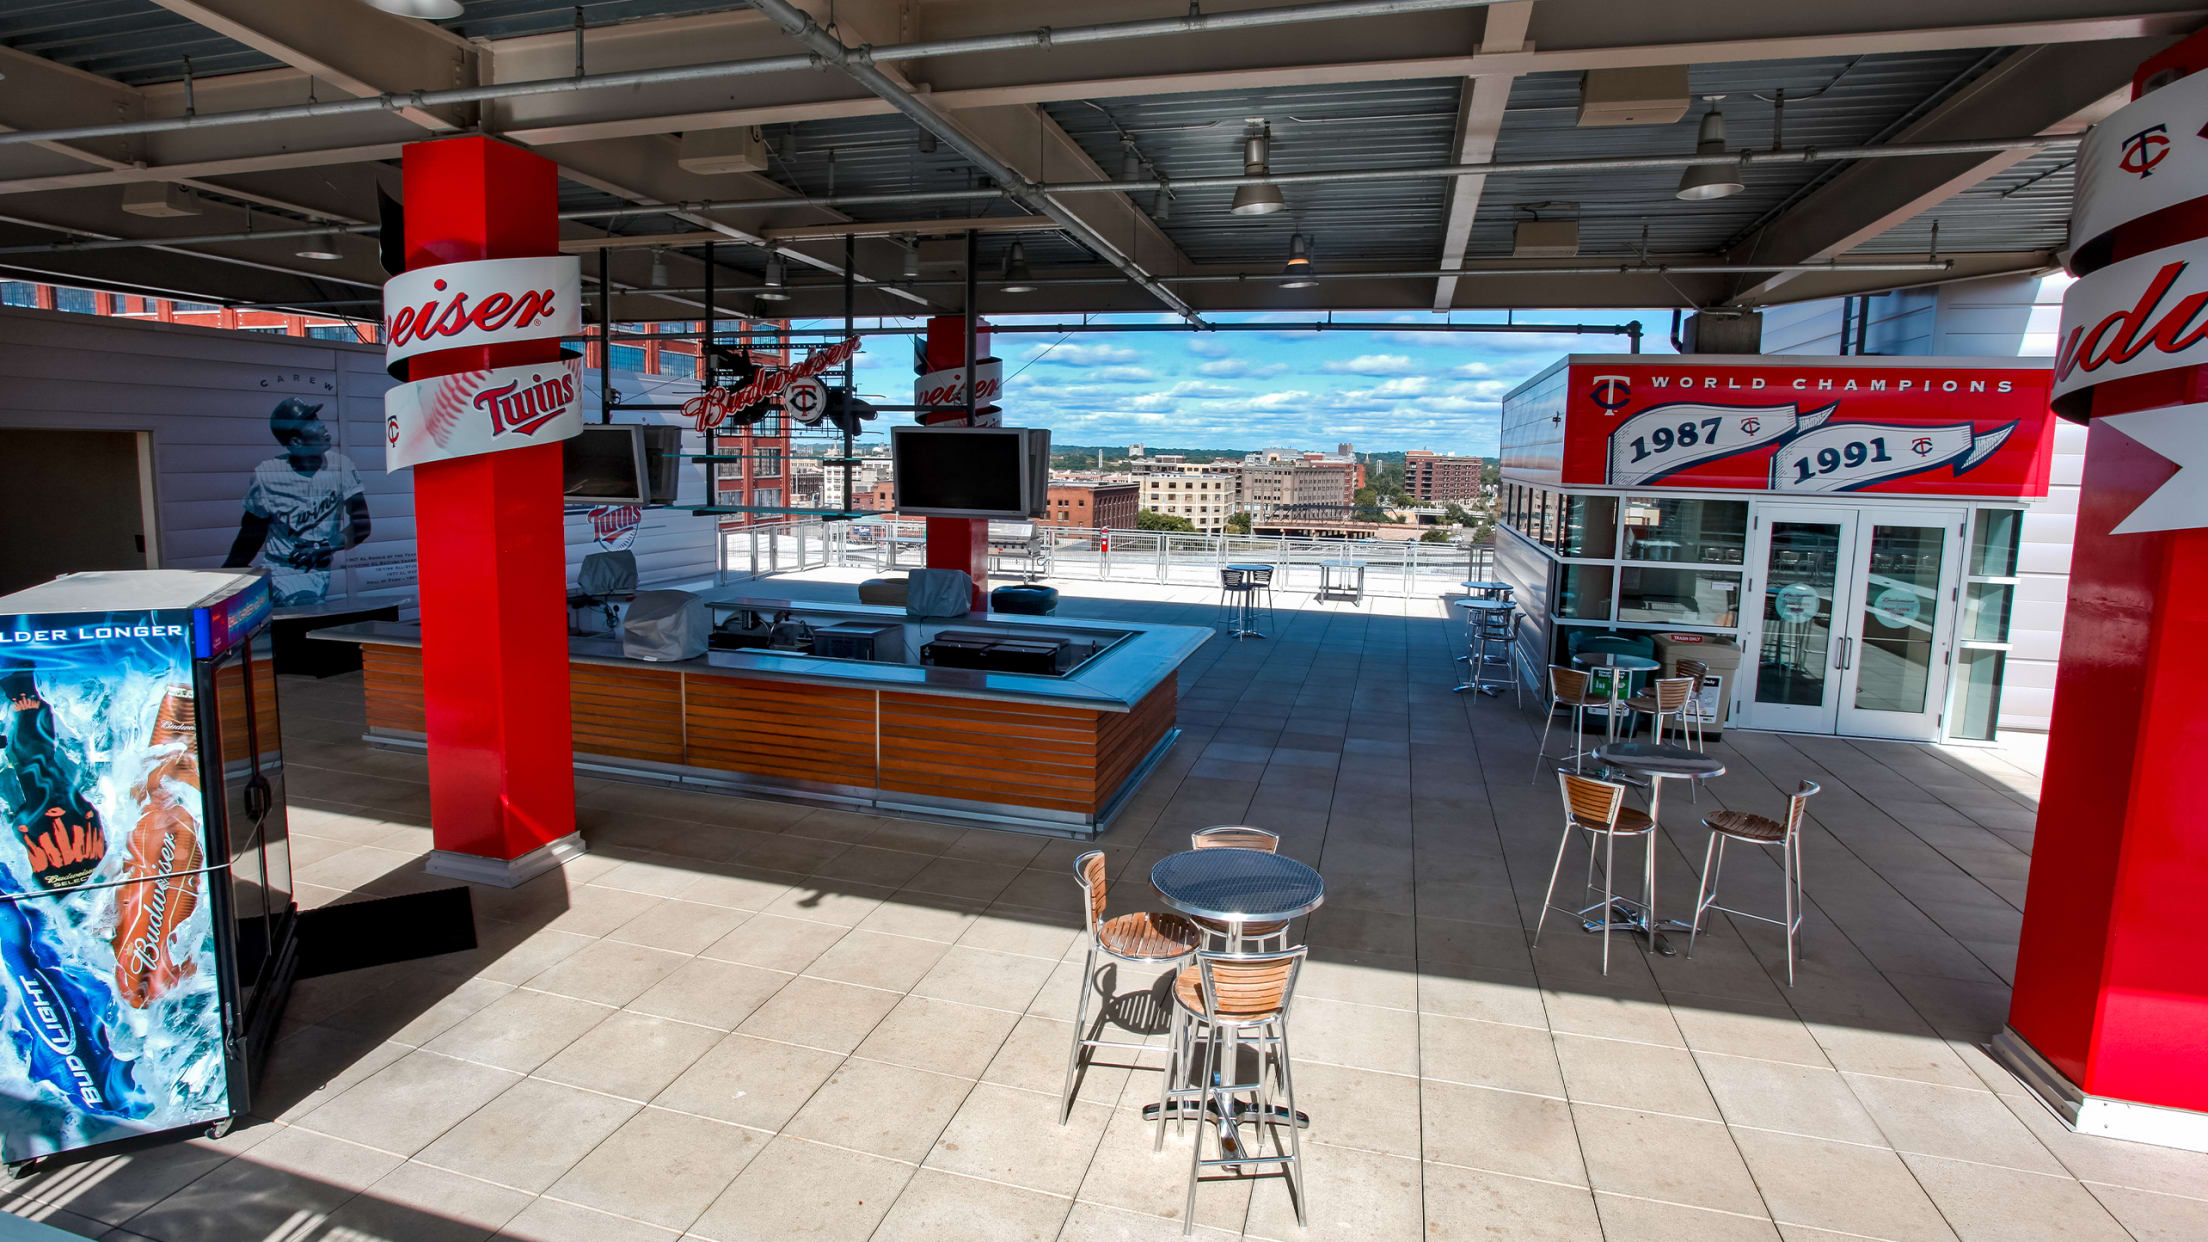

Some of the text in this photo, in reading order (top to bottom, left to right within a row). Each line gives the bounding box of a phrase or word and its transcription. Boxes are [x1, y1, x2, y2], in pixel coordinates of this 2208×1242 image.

[260, 374, 334, 391] CAREW
[680, 334, 862, 432] Budweiser
[917, 374, 1000, 406] weier
[1651, 376, 2014, 393] WORLD CHAMPIONS
[473, 374, 575, 437] Twins
[1630, 416, 1723, 464] 1987
[1794, 437, 1892, 485] 1991
[587, 505, 642, 543] Twins
[0, 625, 183, 643] LDER LONGER
[19, 974, 104, 1109] BUD LIGHT
